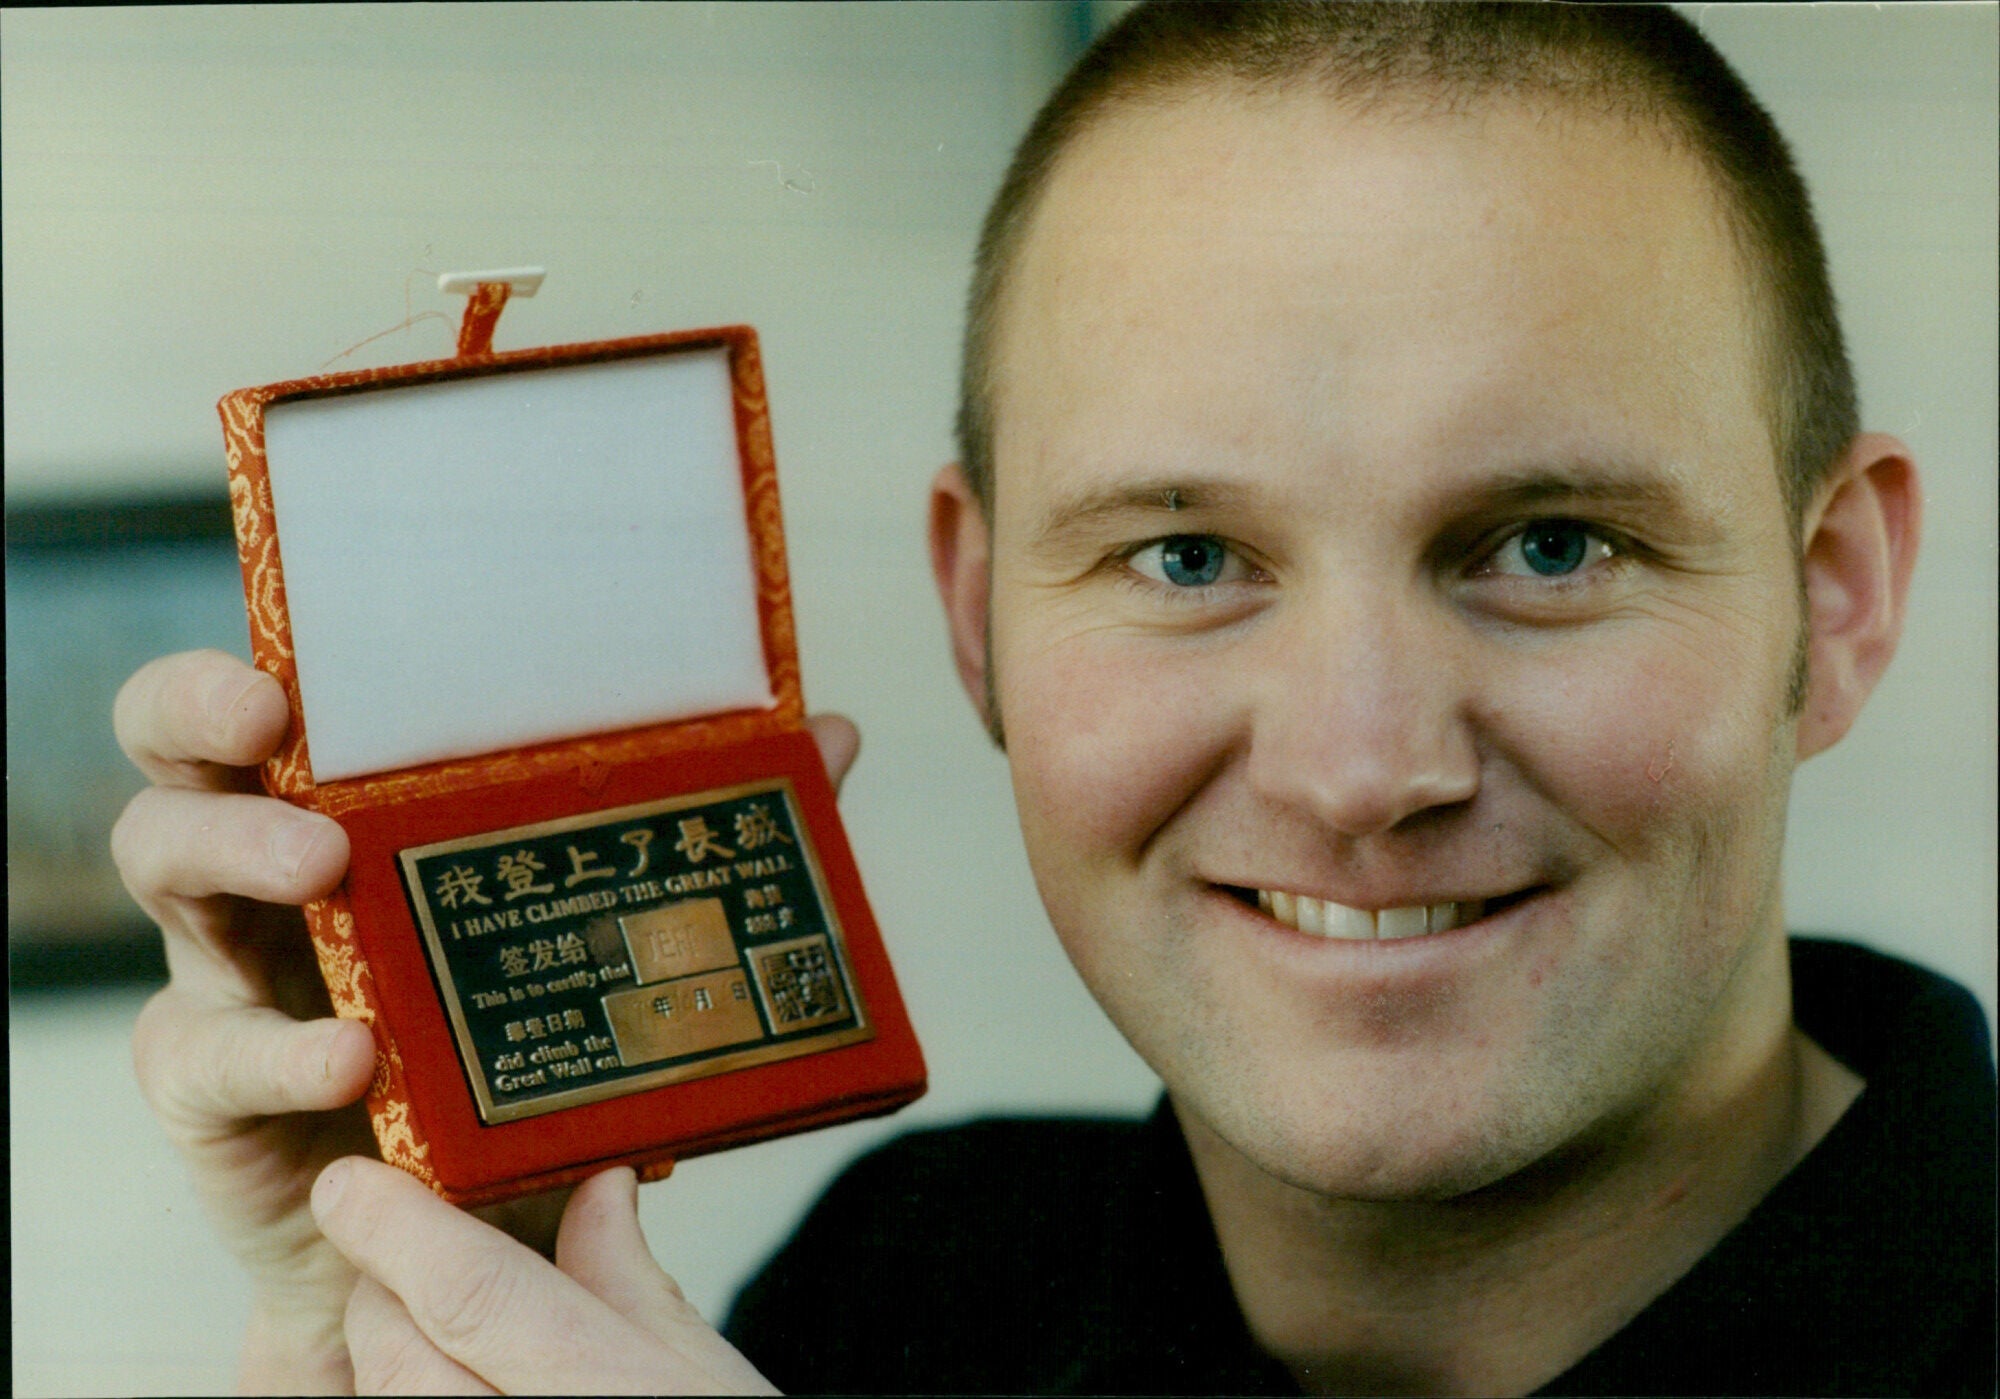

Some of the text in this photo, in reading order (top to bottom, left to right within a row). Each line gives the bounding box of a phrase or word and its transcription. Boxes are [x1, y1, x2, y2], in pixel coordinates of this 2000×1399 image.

[435, 803, 793, 909] 我登上了長城
[451, 854, 793, 940] I HAVE CLIMBED THE GREAT WALL
[500, 932, 588, 978] 签发给
[472, 962, 630, 1009] This is to certify that
[653, 995, 673, 1019] 年
[694, 987, 713, 1012] 月
[494, 1034, 613, 1071] did climb the
[494, 1055, 619, 1092] Great Wall on
